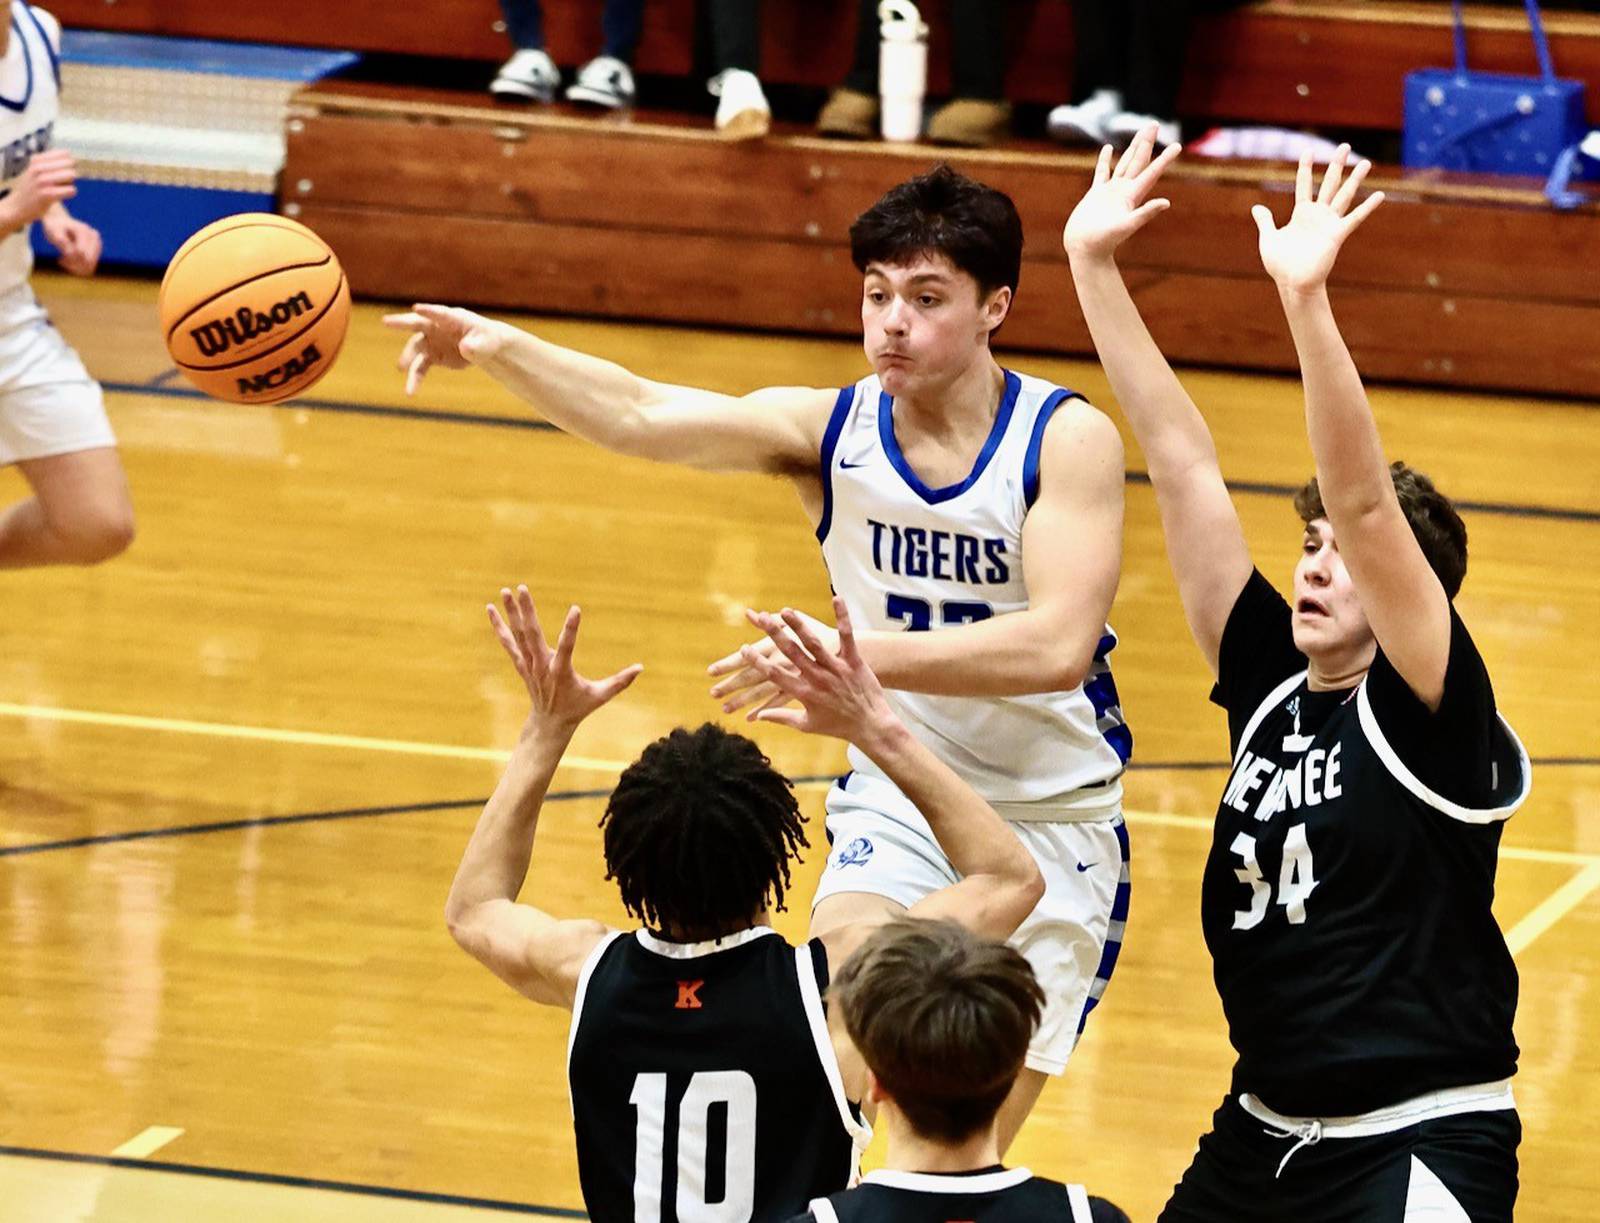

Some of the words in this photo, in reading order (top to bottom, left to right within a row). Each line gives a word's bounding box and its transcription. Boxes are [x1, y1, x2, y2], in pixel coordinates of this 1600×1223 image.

[190, 290, 314, 357] Wilson
[236, 343, 322, 395] NCAA
[867, 518, 1010, 585] TIGERS
[1229, 822, 1321, 931] 34
[674, 979, 704, 1009] K
[628, 1069, 757, 1223] 10
